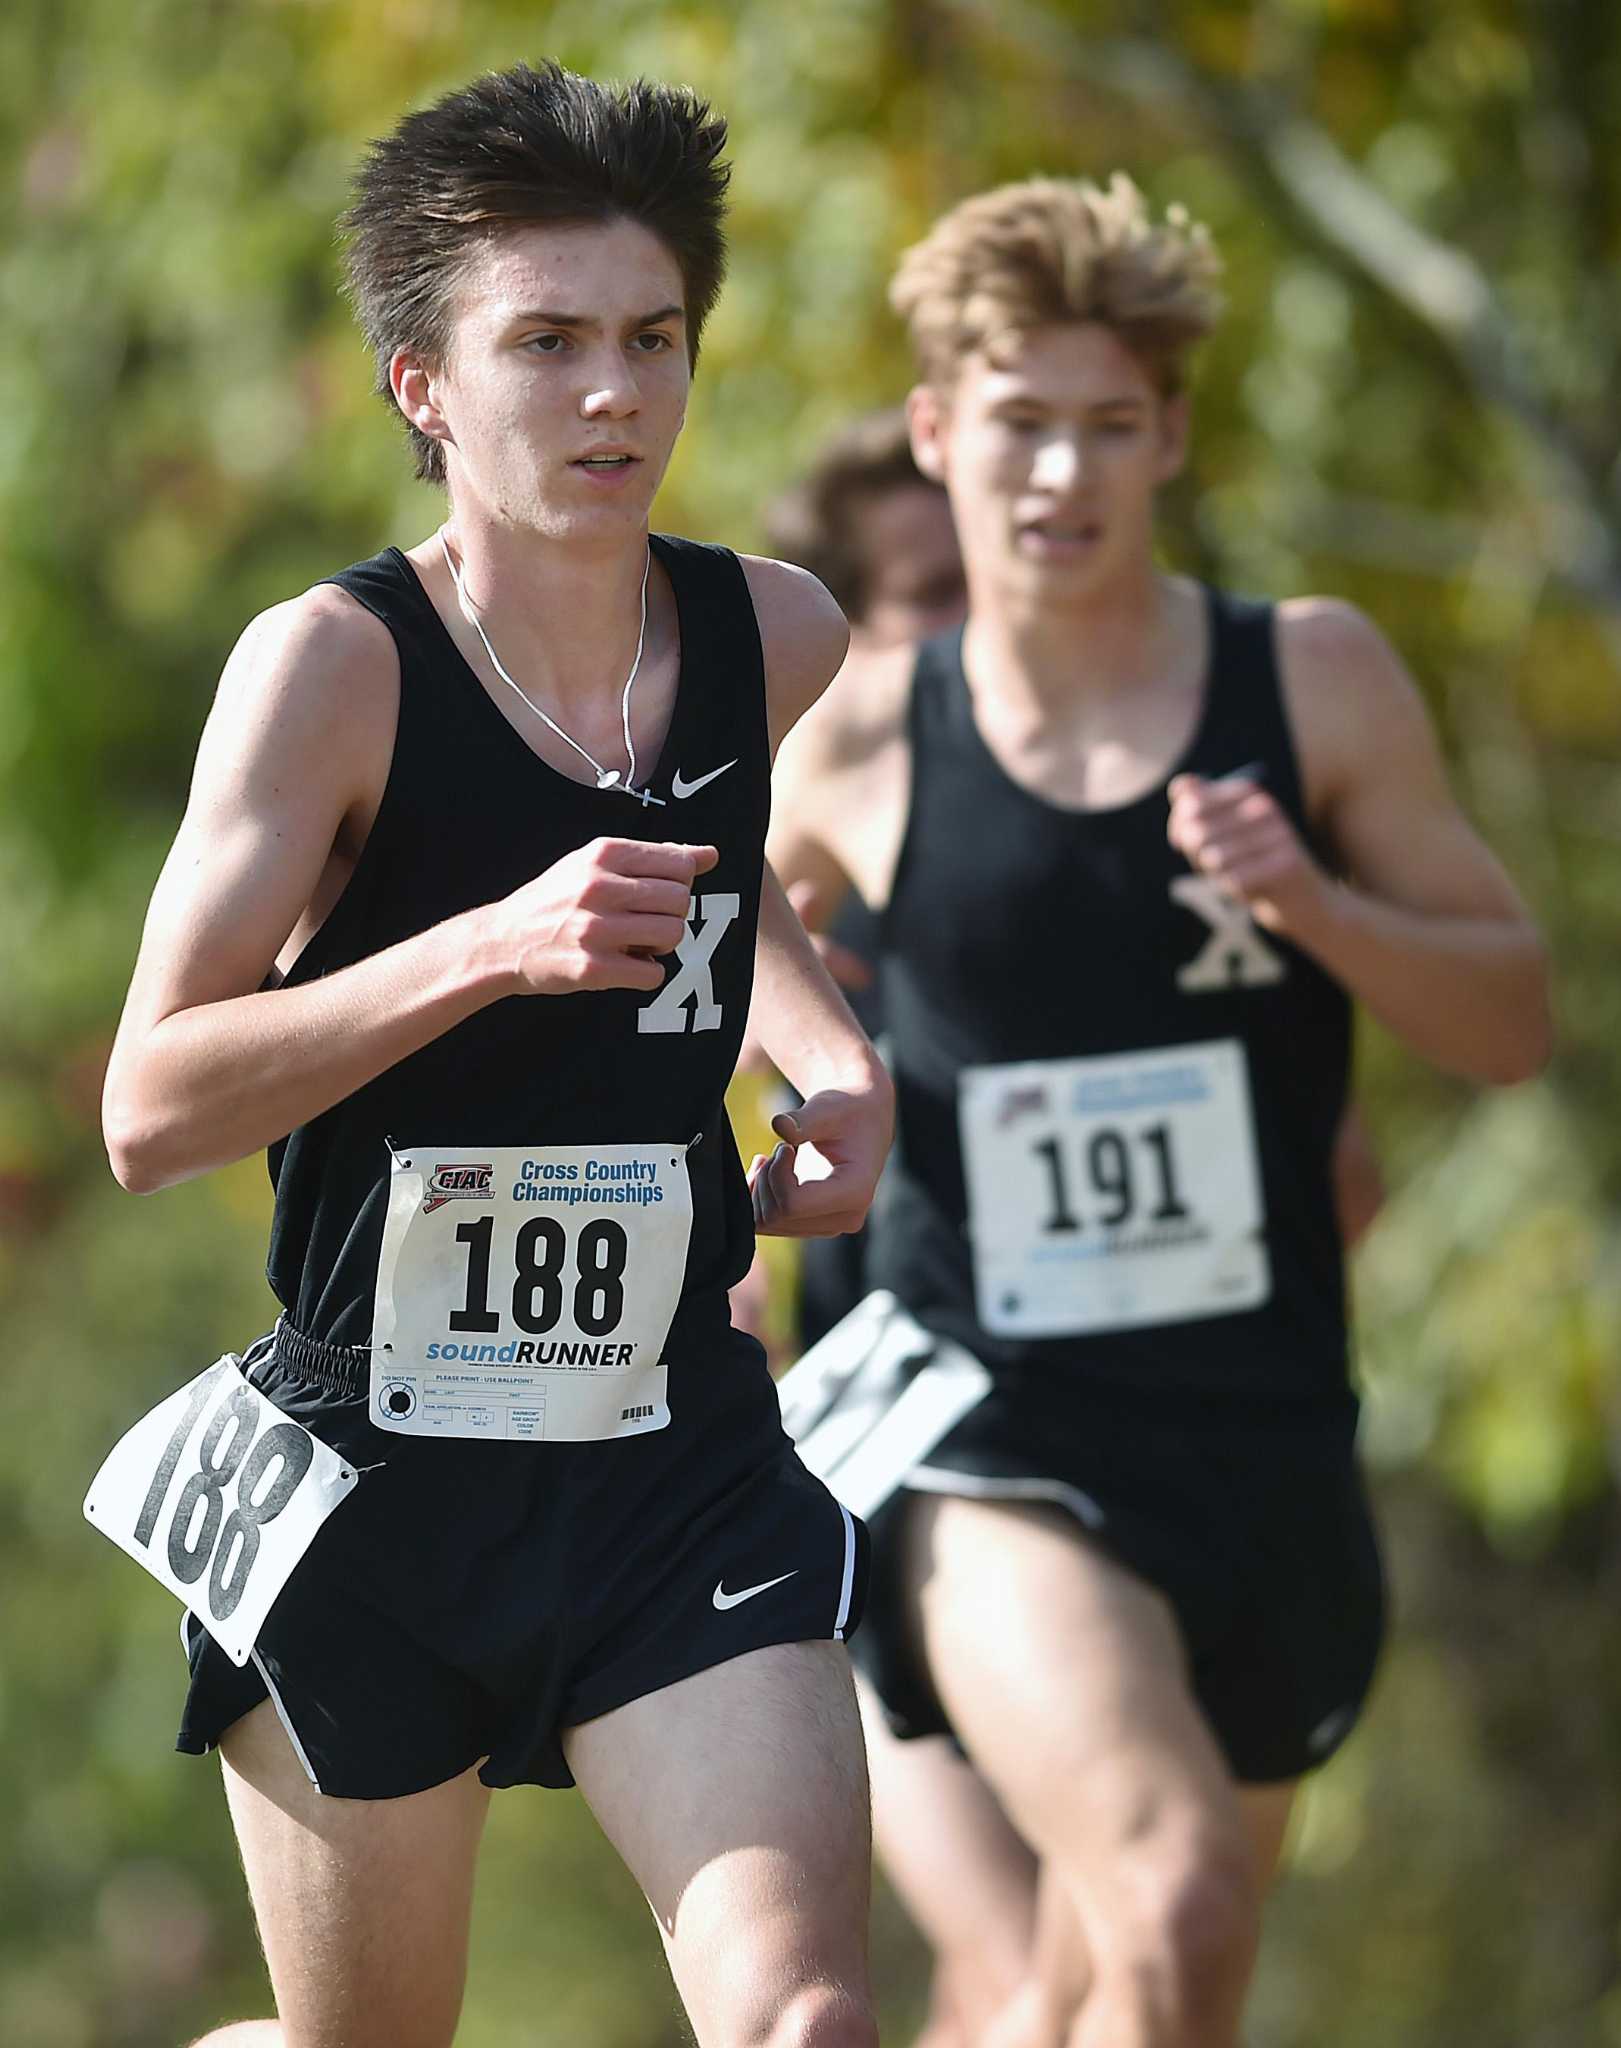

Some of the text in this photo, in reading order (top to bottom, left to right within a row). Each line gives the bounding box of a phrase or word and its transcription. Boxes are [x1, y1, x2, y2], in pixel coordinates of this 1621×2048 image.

[637, 893, 740, 1033] X
[438, 1170, 494, 1191] CIAC
[512, 1182, 663, 1207] Championships
[521, 1160, 657, 1183] Cross Country
[1030, 1119, 1190, 1234] 191
[448, 1216, 628, 1337] 188
[133, 1360, 314, 1621] 188
